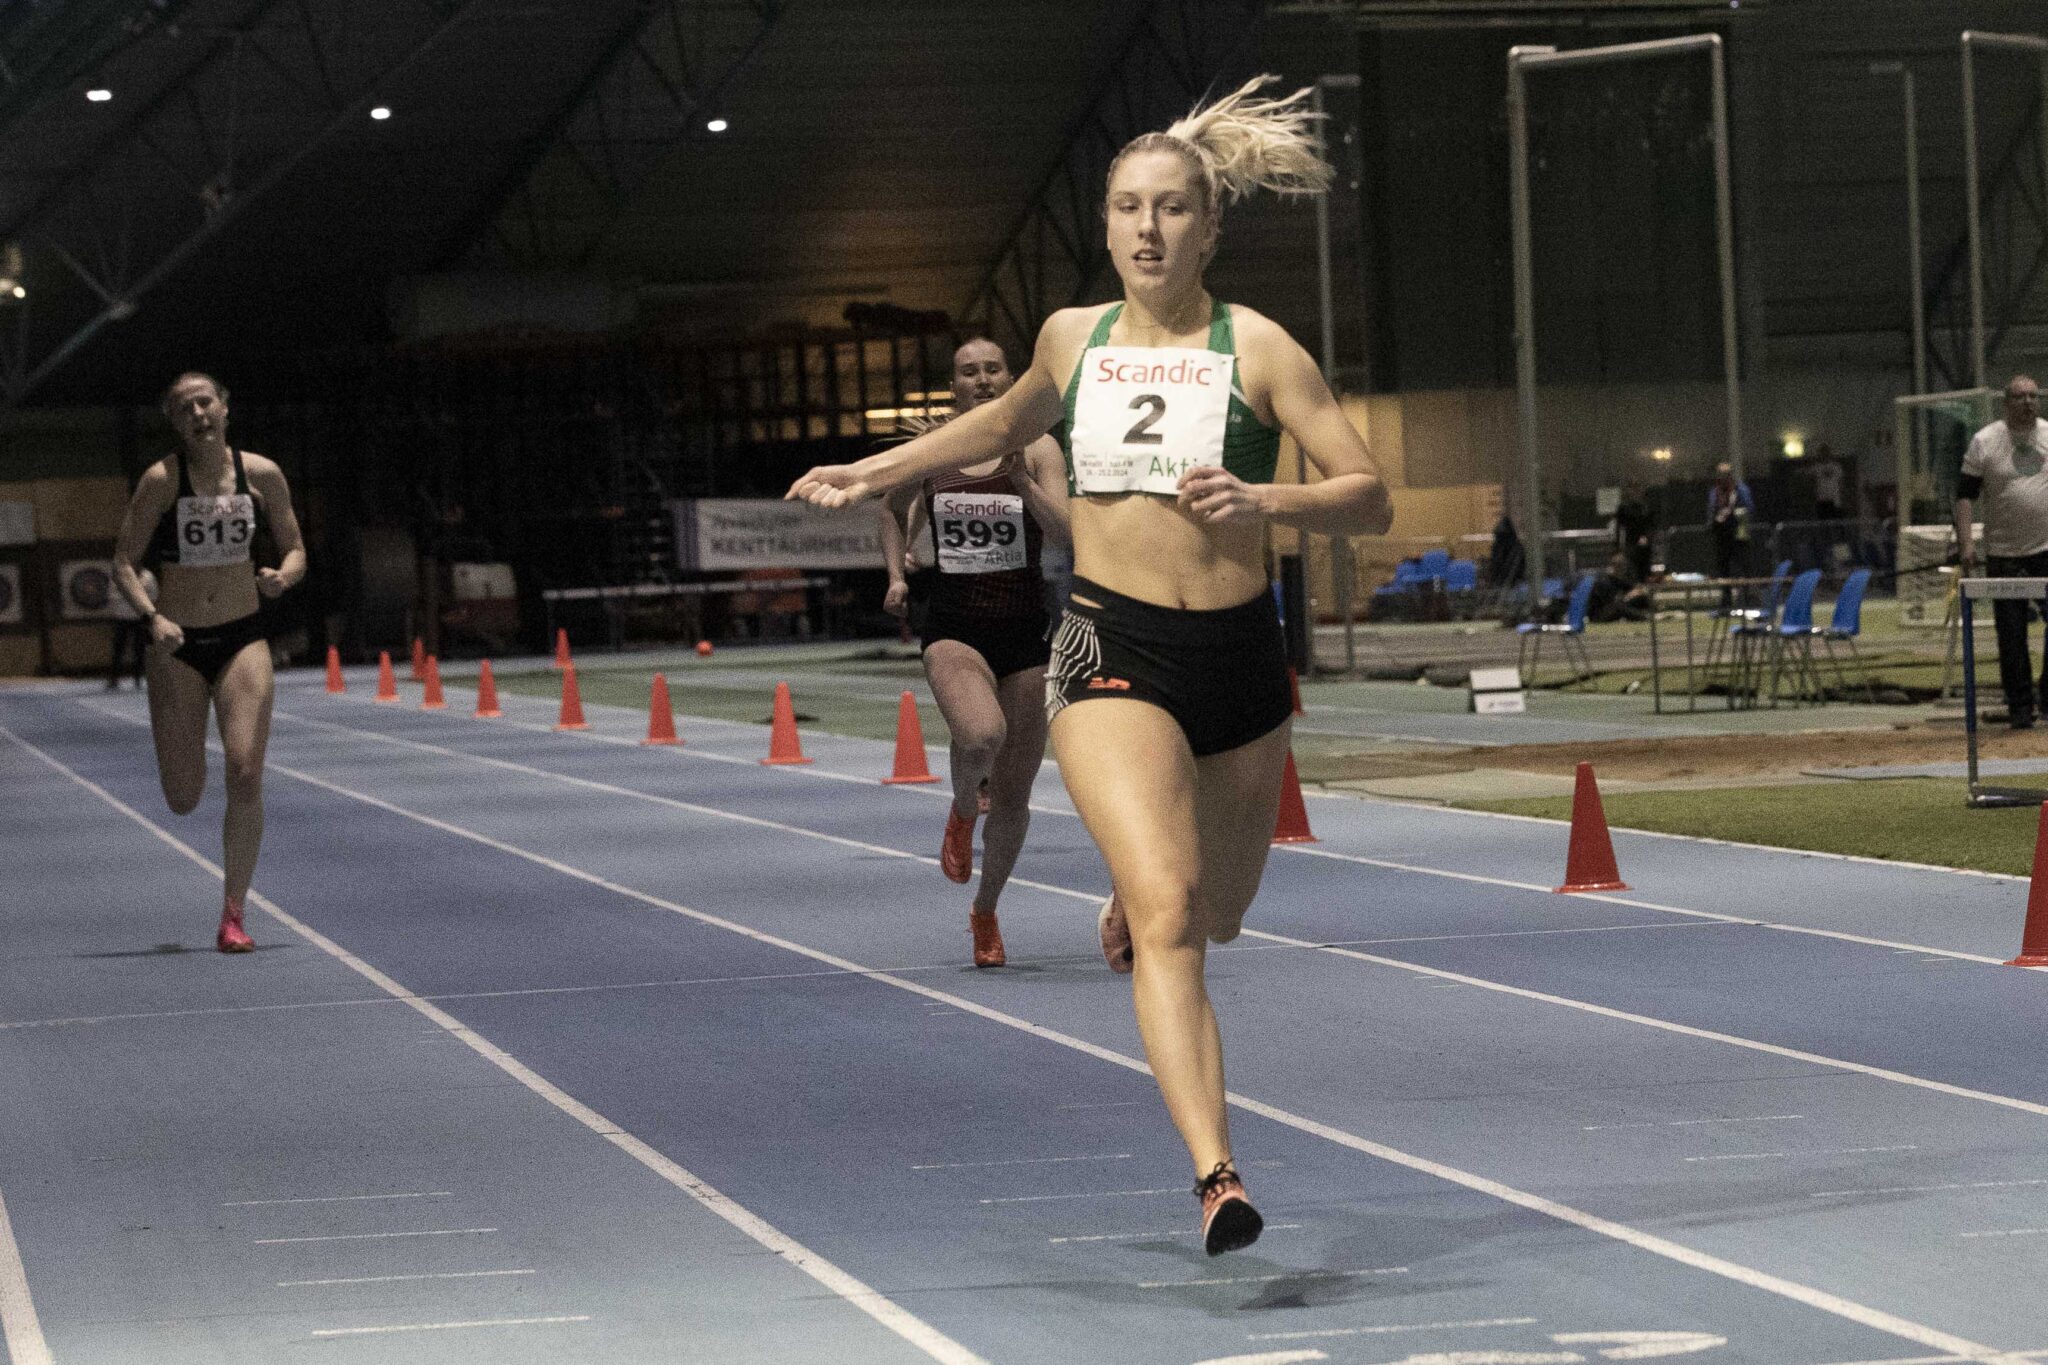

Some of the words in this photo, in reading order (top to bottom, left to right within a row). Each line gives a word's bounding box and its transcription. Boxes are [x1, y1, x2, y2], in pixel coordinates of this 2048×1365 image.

[1097, 358, 1212, 385] Scandic
[1122, 394, 1166, 444] 2
[1148, 456, 1210, 478] Akt
[944, 500, 1012, 516] Scandic
[184, 518, 248, 546] 613
[943, 520, 1017, 548] 599
